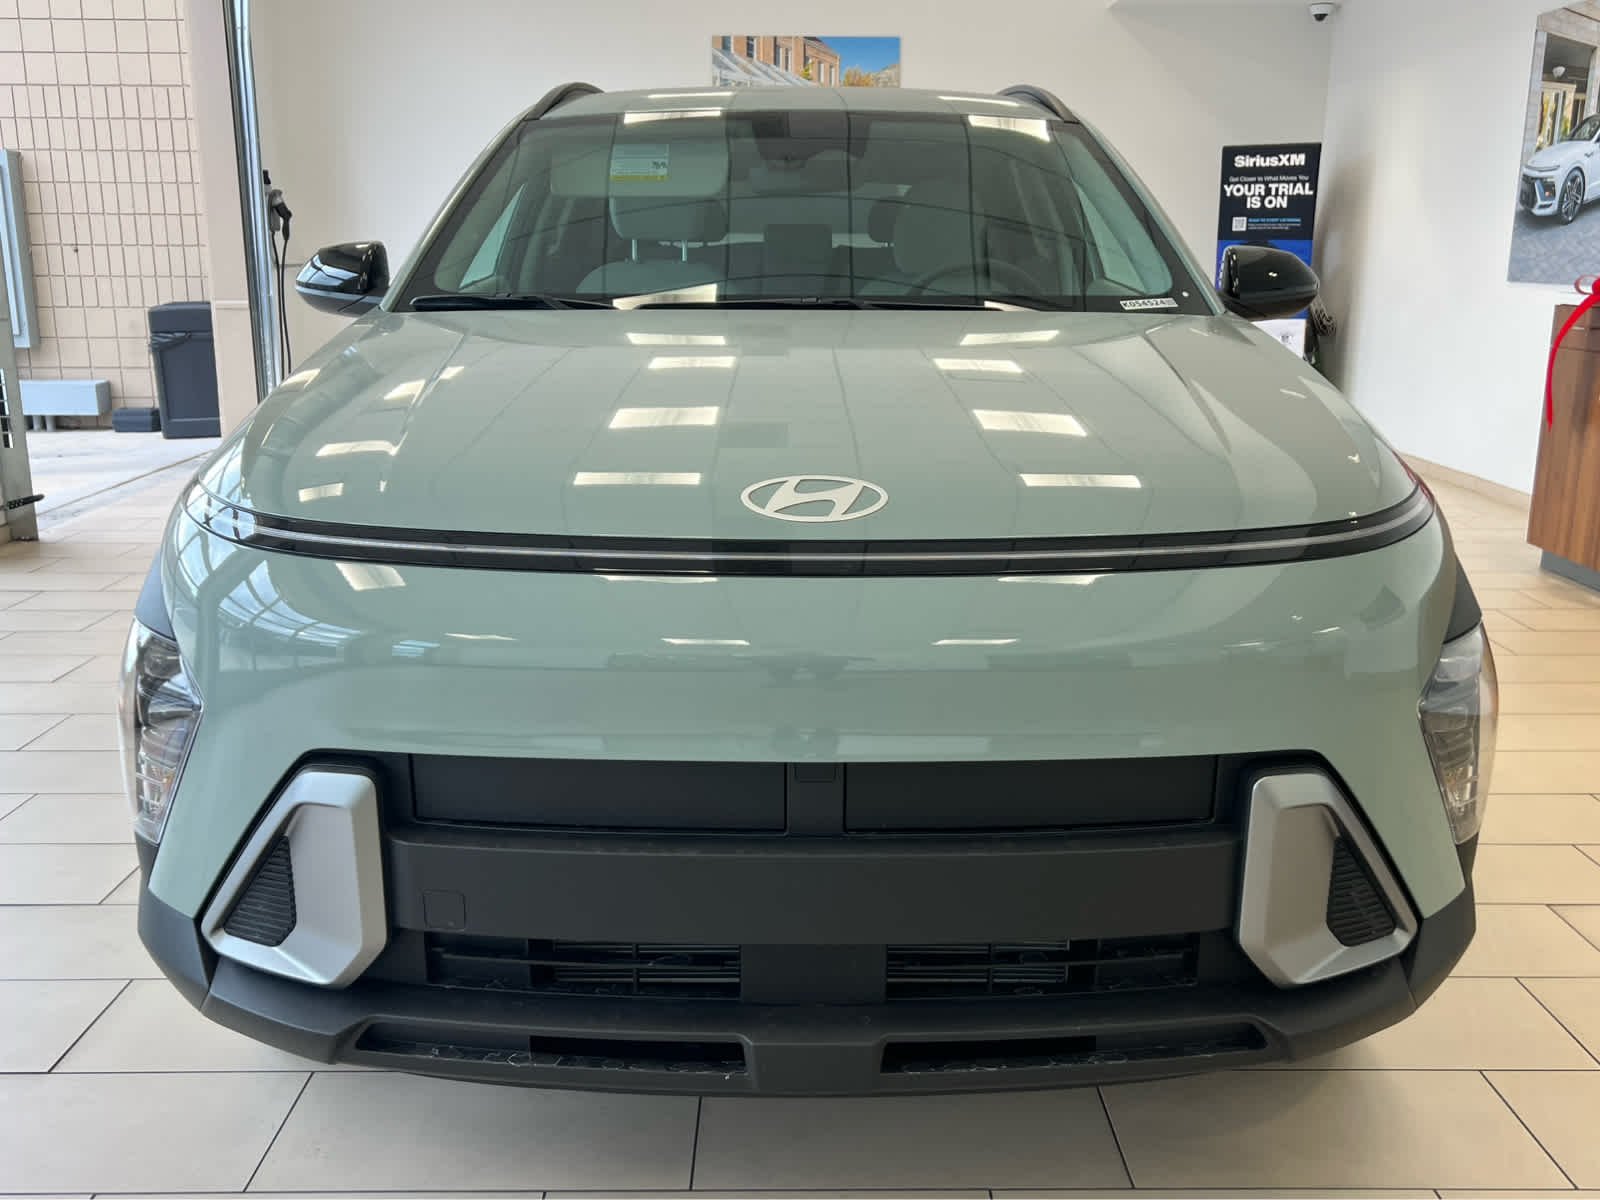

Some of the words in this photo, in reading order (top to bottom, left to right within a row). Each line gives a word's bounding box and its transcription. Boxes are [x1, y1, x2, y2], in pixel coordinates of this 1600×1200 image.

[1234, 153, 1305, 167] SiriusXM
[1224, 184, 1265, 197] YOUR
[1268, 183, 1313, 195] TRIAL
[1246, 197, 1261, 208] IS
[1264, 197, 1287, 208] ON
